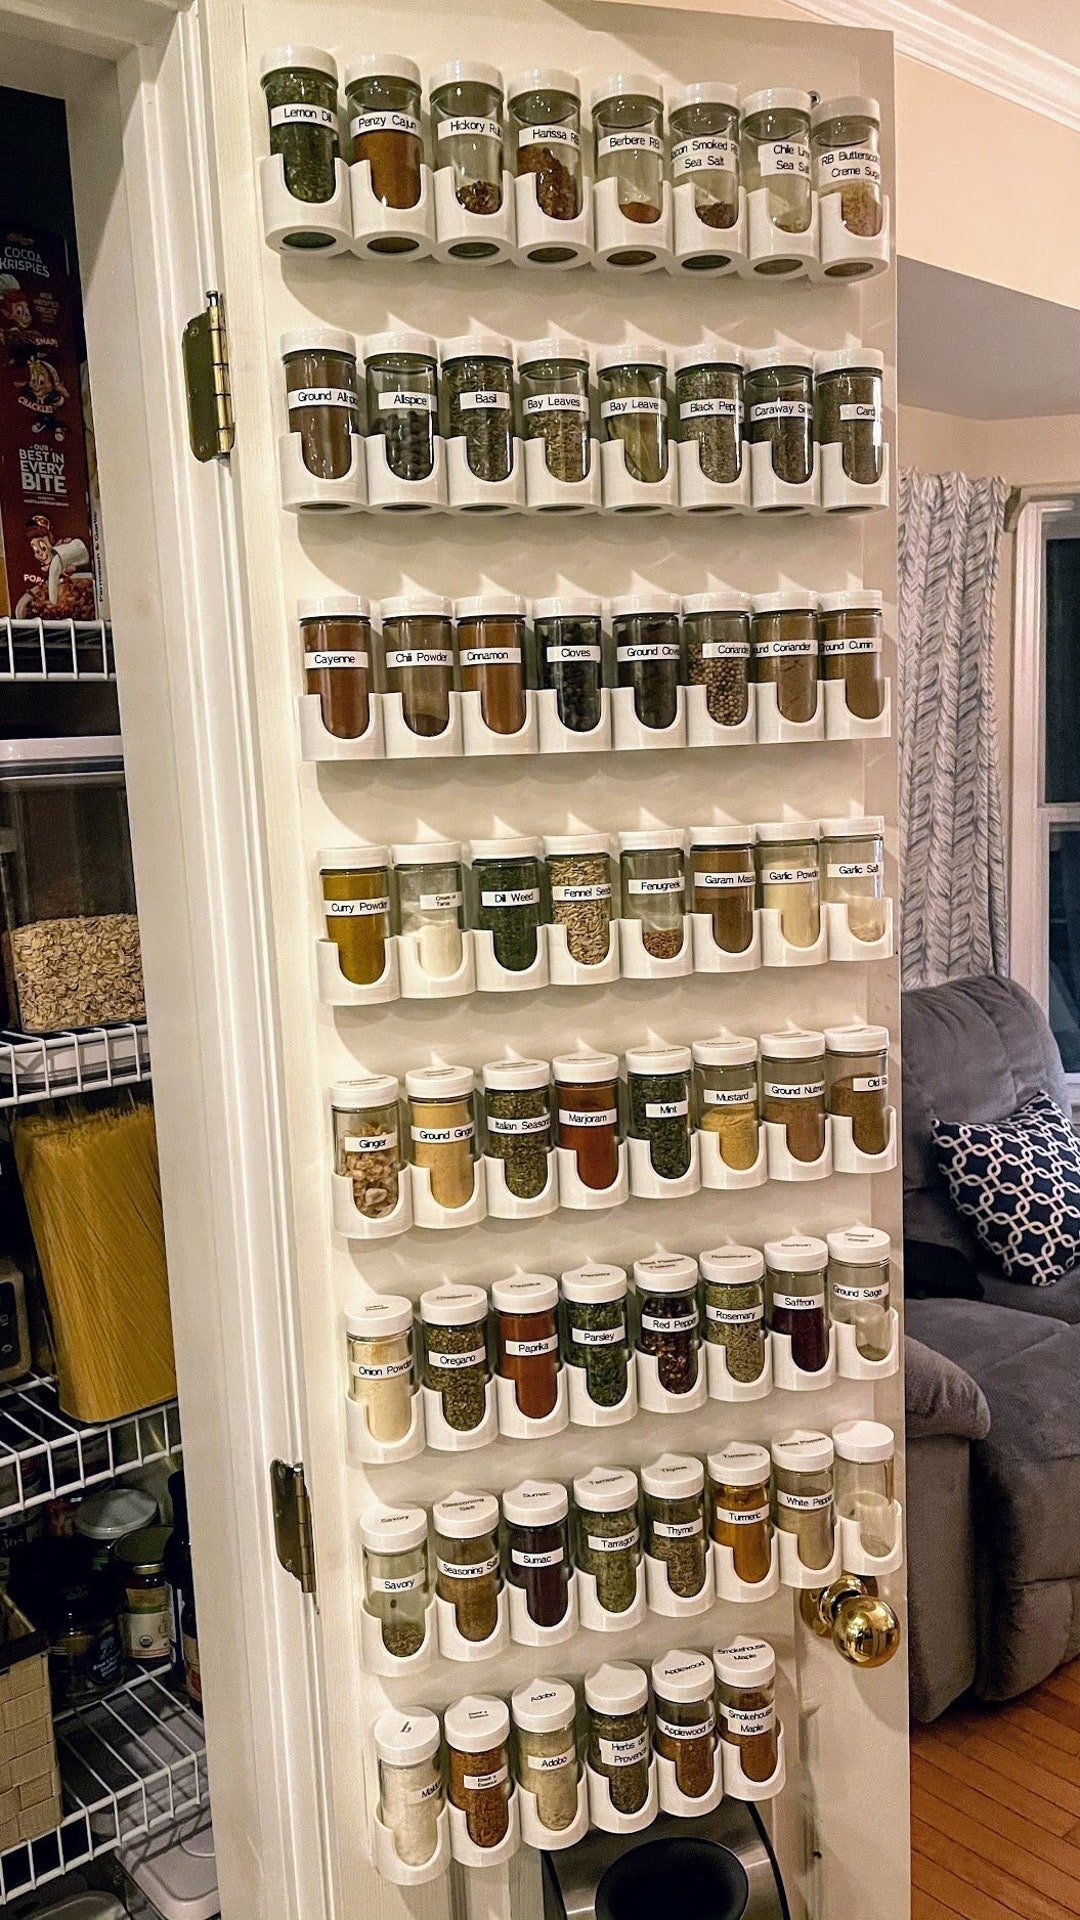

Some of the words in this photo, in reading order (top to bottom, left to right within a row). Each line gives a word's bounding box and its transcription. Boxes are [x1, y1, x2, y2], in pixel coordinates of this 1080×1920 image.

[283, 108, 317, 119] Lemon
[358, 116, 387, 130] Penzy
[391, 115, 417, 130] Cajun
[450, 120, 485, 134] Hickory
[532, 128, 567, 141] Harissa
[609, 137, 646, 149] Berbere
[649, 137, 660, 149] RB
[692, 141, 728, 152] Smoked
[773, 144, 794, 155] Chile
[684, 159, 702, 169] Sea
[707, 156, 724, 167] Salt
[776, 160, 794, 170] Sea
[821, 155, 834, 166] RB
[831, 167, 860, 178] Creme
[4, 246, 43, 264] COCOA
[0, 257, 50, 278] KRISPIES
[297, 391, 332, 402] Ground
[393, 394, 427, 406] Allspice
[475, 394, 497, 404] Basil
[527, 399, 544, 409] Bay
[548, 396, 581, 407] Leaves
[609, 401, 627, 412] Bay
[690, 401, 714, 412] Black
[754, 404, 794, 417] Caraway
[33, 443, 49, 452] OUR
[19, 448, 49, 461] BEST
[51, 452, 65, 464] IN
[20, 459, 65, 476] EVERY
[21, 471, 67, 494] BITE
[23, 573, 44, 586] POP!
[96, 552, 104, 602] Parmesan
[772, 642, 811, 653] Coriander
[849, 640, 874, 651] Cumin
[466, 650, 509, 661] Cinnamon
[560, 648, 591, 659] Cloves
[626, 646, 658, 657] Ground
[314, 654, 356, 666] Cayenne
[395, 653, 412, 663] Chili
[417, 652, 448, 662] Powder
[838, 865, 862, 875] Garlic
[704, 874, 734, 885] Garam
[769, 871, 794, 881] Garlic
[640, 880, 681, 893] Fenugreek
[510, 891, 534, 902] Weed
[563, 887, 592, 898] Fennel
[331, 902, 354, 914] Curry
[359, 900, 388, 912] Powder
[867, 1078, 880, 1089] Old
[771, 1084, 800, 1095] Ground
[715, 1091, 749, 1102] Mustard
[659, 1104, 678, 1115] Mint
[568, 1112, 607, 1124] Marjoram
[494, 1120, 519, 1130] Italian
[419, 1129, 450, 1140] Ground
[358, 1138, 387, 1150] Ginger
[831, 1283, 860, 1298] Ground
[863, 1288, 882, 1299] Sage
[784, 1297, 815, 1307] Saffron
[715, 1310, 756, 1321] Rosemary
[652, 1319, 671, 1330] Red
[674, 1316, 697, 1329] Pepper
[583, 1332, 614, 1344] Parsley
[518, 1341, 549, 1354] Paprika
[439, 1354, 476, 1367] Oregano
[358, 1365, 383, 1376] Onion
[522, 1491, 551, 1499] Sumac
[786, 1496, 809, 1507] White
[380, 1514, 409, 1523] Savory
[728, 1511, 762, 1522] Turmeric
[666, 1525, 694, 1537] Thyme
[601, 1533, 635, 1549] Tarragon
[522, 1554, 552, 1564] Sumac
[442, 1564, 483, 1576] Seasoning
[384, 1577, 415, 1590] Savory
[717, 1643, 766, 1655] Smokehouse
[733, 1653, 756, 1661] Maple
[664, 1660, 705, 1675] Applewood
[530, 1691, 556, 1703] Adobo
[664, 1724, 706, 1737] Applewood
[740, 1722, 764, 1734] Maple
[611, 1741, 635, 1751] Herbs
[541, 1755, 568, 1768] Adobo
